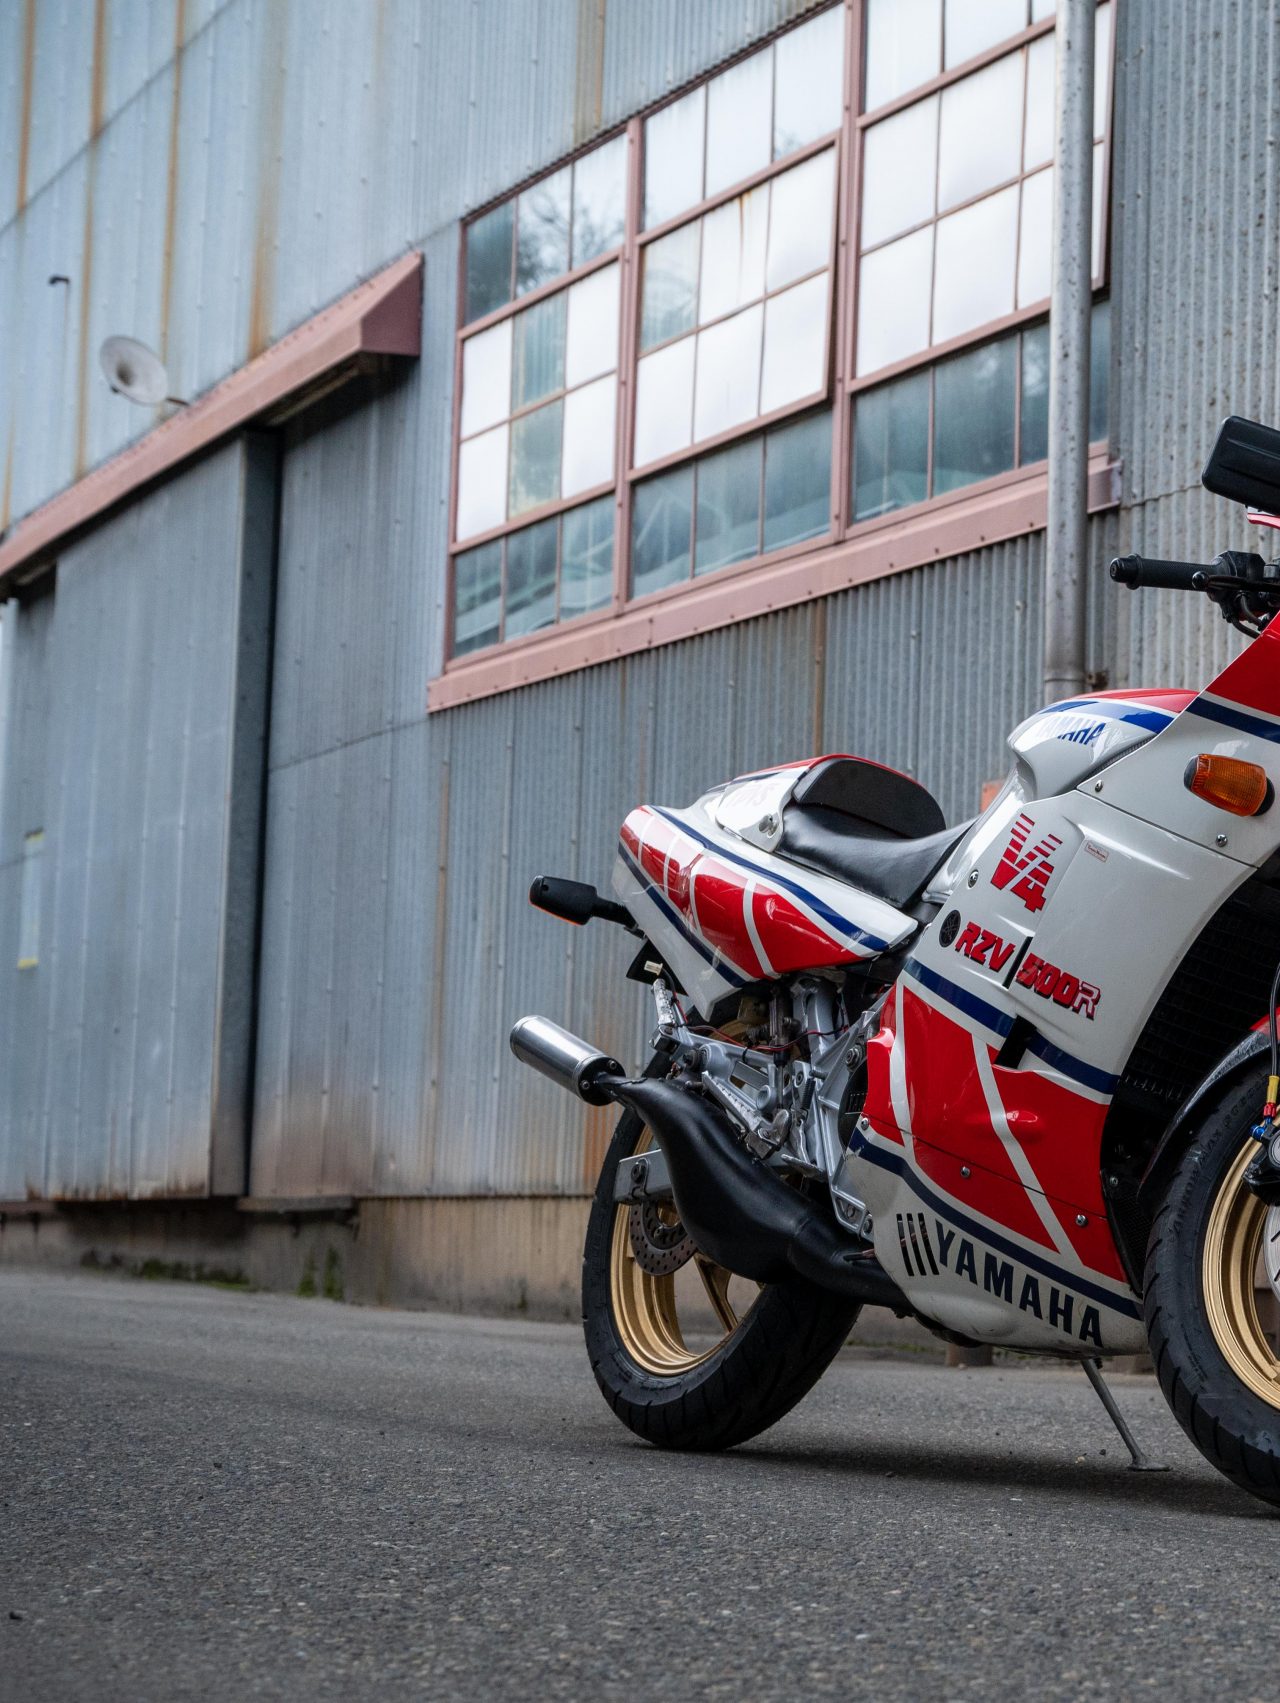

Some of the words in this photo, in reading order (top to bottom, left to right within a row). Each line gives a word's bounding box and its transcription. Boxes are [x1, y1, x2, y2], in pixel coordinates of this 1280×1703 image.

[990, 813, 1063, 913] V4
[955, 921, 1016, 973] RZV
[1015, 953, 1101, 1021] 500R
[935, 1219, 1103, 1348] YAMAHA
